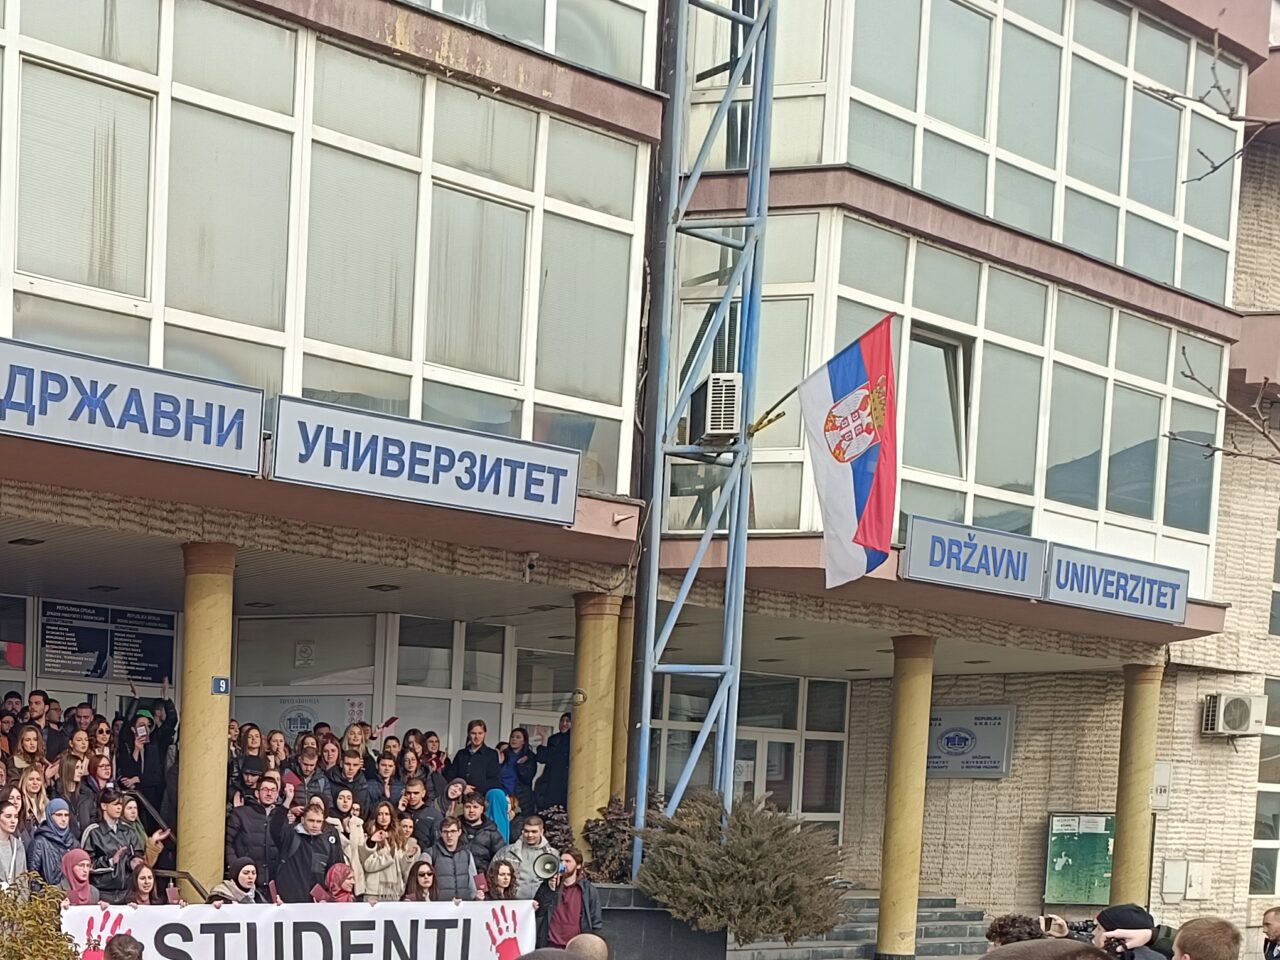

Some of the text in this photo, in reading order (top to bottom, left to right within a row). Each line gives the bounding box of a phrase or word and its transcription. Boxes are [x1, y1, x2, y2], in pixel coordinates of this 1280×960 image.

[296, 420, 569, 505] УНИВЕРЗИТЕТ
[929, 533, 1181, 610] DRŽAVNI UNIVERZITET
[219, 680, 226, 692] 9
